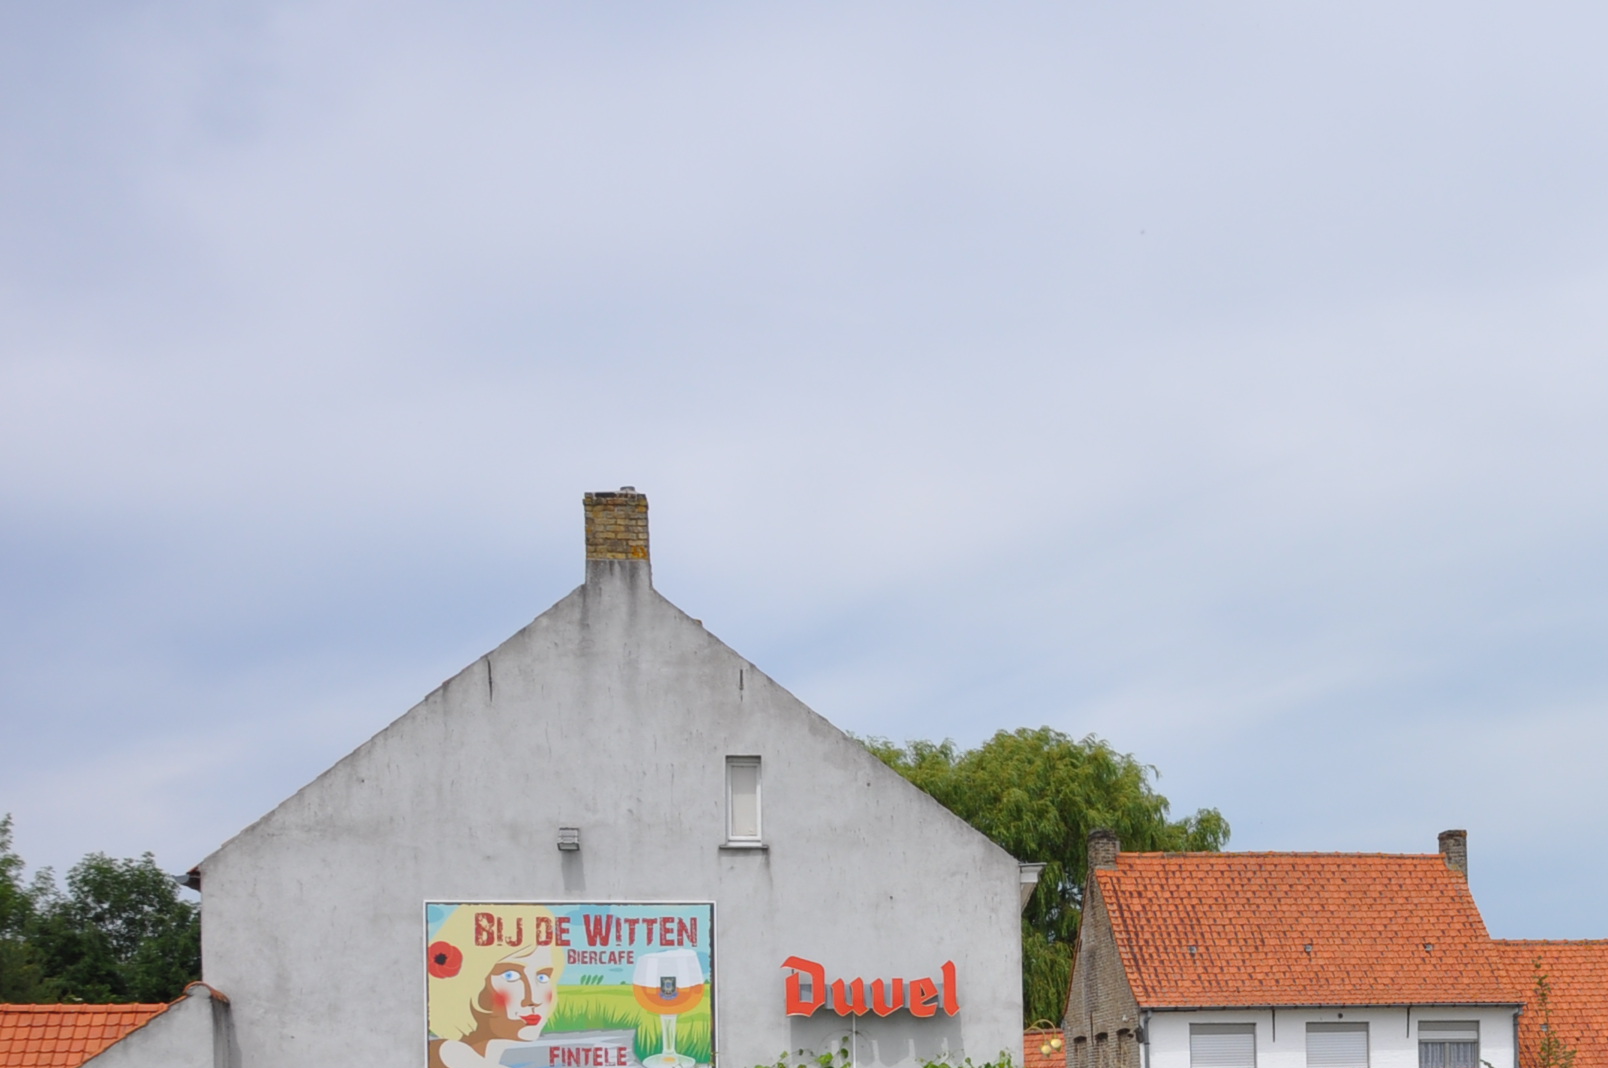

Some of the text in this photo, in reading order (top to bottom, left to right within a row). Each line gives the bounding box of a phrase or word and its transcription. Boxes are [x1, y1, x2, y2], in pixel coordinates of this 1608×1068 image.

[475, 912, 698, 947] BIJ DE WITTEN
[567, 949, 634, 965] BIERCAFE
[780, 955, 961, 1018] Duvel
[549, 1046, 628, 1067] FINTELE
